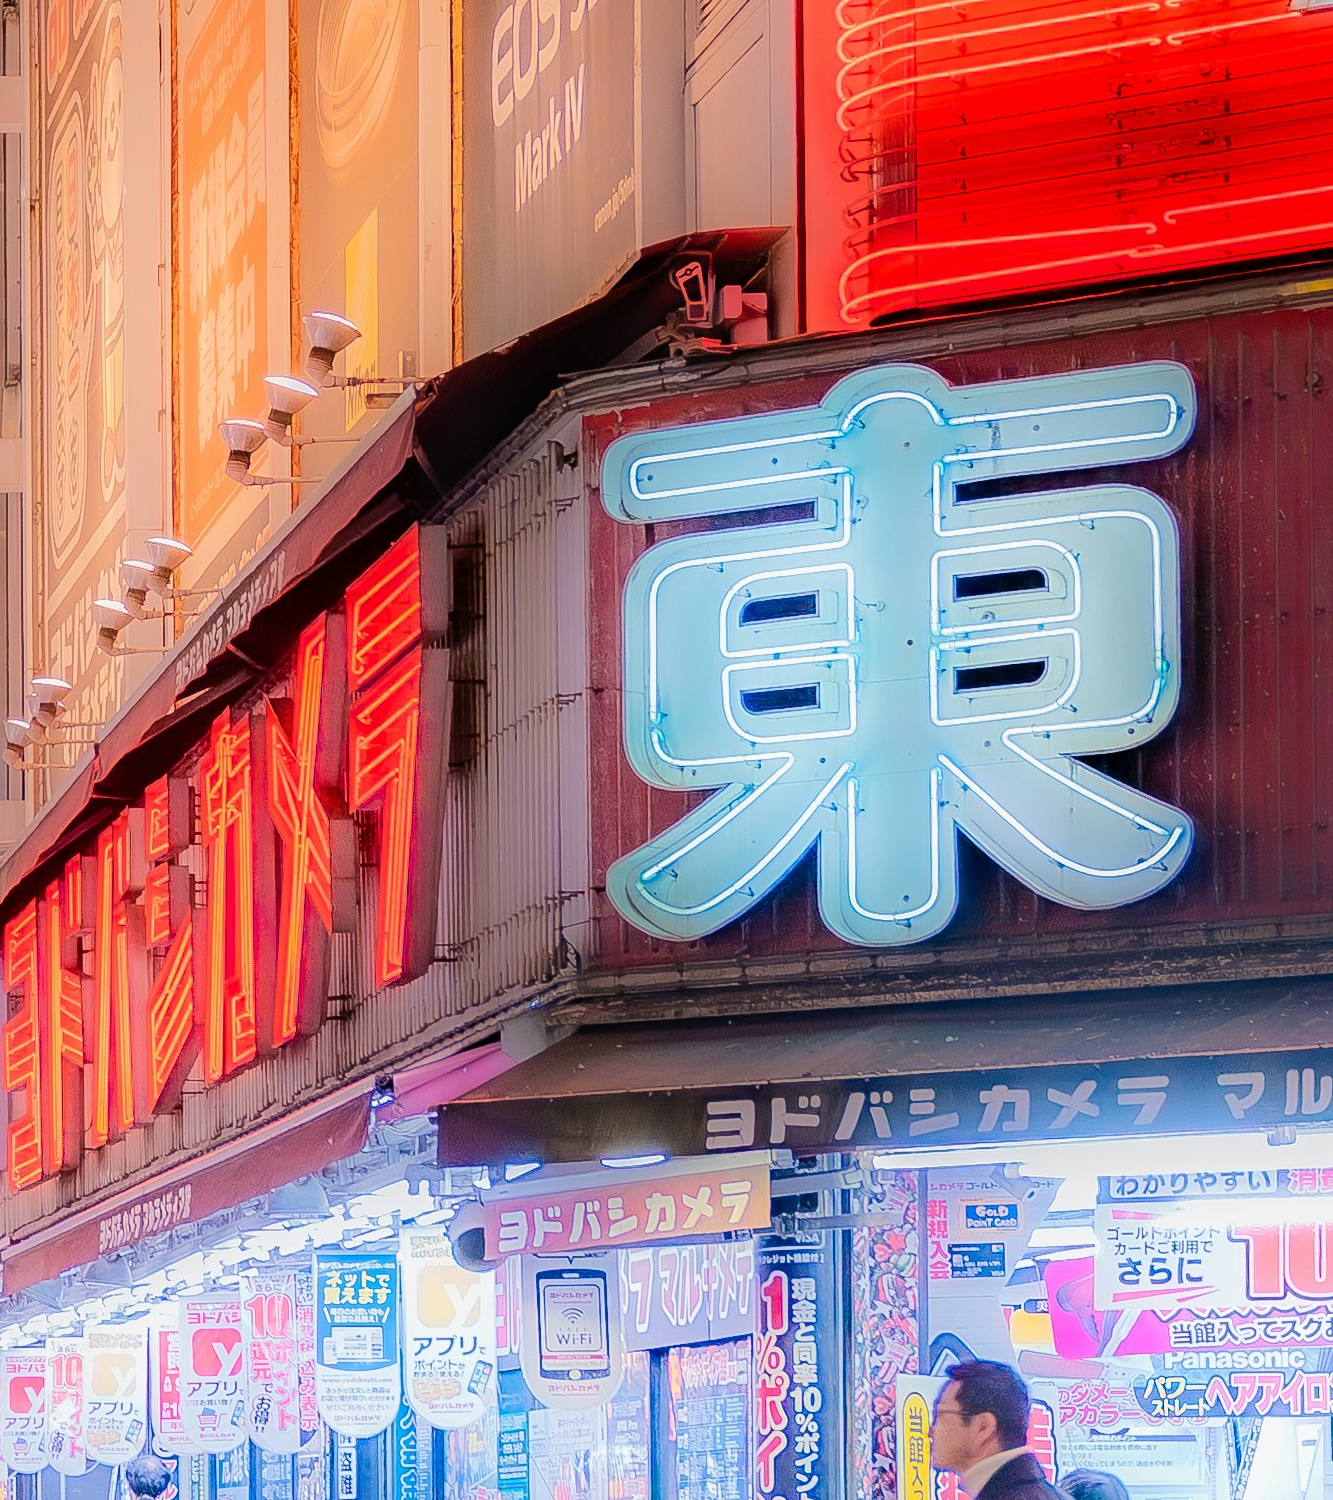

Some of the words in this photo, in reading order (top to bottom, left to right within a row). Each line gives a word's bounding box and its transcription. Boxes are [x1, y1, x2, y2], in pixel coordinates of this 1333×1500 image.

[514, 90, 562, 214] Mark
[564, 60, 586, 156] IV
[189, 70, 267, 316] 新規会員
[197, 253, 257, 453] 募集中
[600, 361, 1197, 948] 東
[1, 519, 423, 1193] ヨドバシカメラ
[705, 1074, 1171, 1149] ヨドバシカメラ
[1115, 1171, 1272, 1197] わかりやすい
[497, 1180, 754, 1250] ヨドバシカメラ
[966, 1217, 994, 1229] POINT
[993, 1216, 1018, 1228] CARD
[976, 1204, 1009, 1218] GOLD
[926, 1199, 951, 1280] 新規入会
[1106, 1226, 1221, 1241] ゴールドポイント
[1113, 1240, 1214, 1255] カードご利用で
[323, 1270, 391, 1287] ネットで
[1117, 1257, 1203, 1285] さらに
[323, 1286, 392, 1306] 買えます
[244, 1293, 293, 1340] 10
[555, 1331, 594, 1347] Wi-Fi
[1164, 1348, 1306, 1370] Panasonic
[273, 1341, 297, 1432] ポイント
[1142, 1377, 1206, 1400] パワー
